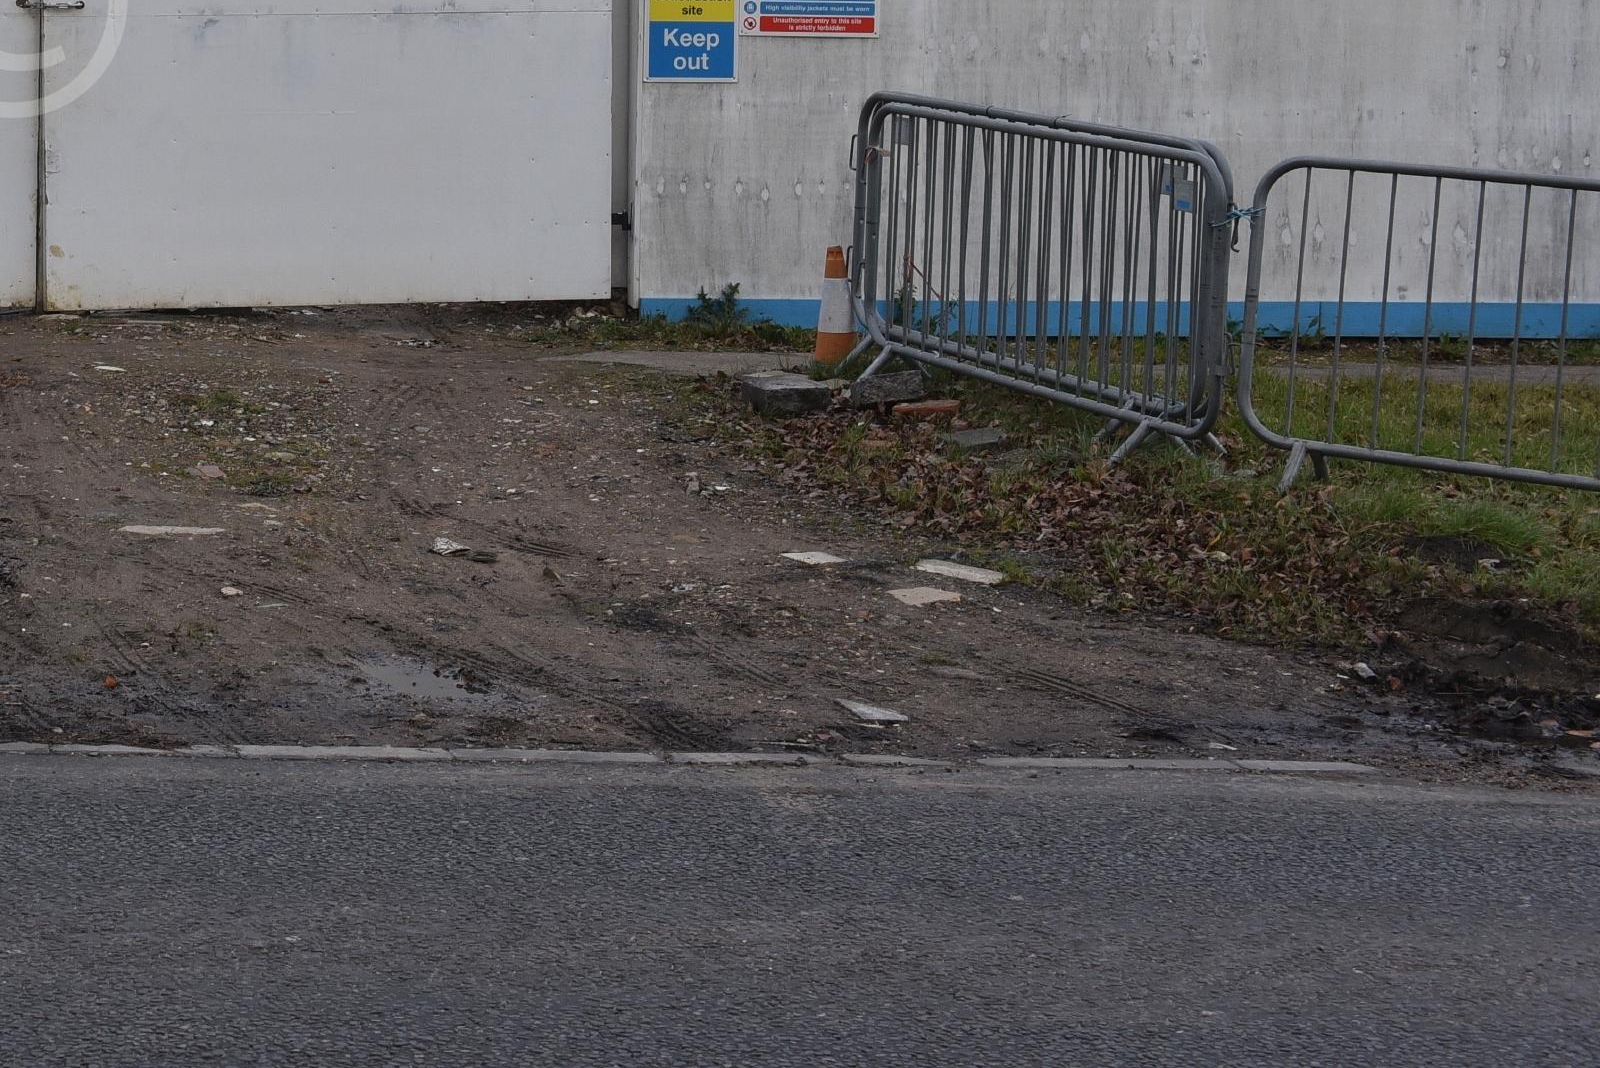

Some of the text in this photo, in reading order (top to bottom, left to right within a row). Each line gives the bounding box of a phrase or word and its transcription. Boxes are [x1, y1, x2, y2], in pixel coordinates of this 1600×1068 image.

[681, 4, 703, 15] site
[663, 28, 720, 51] Keep
[673, 53, 710, 71] out
